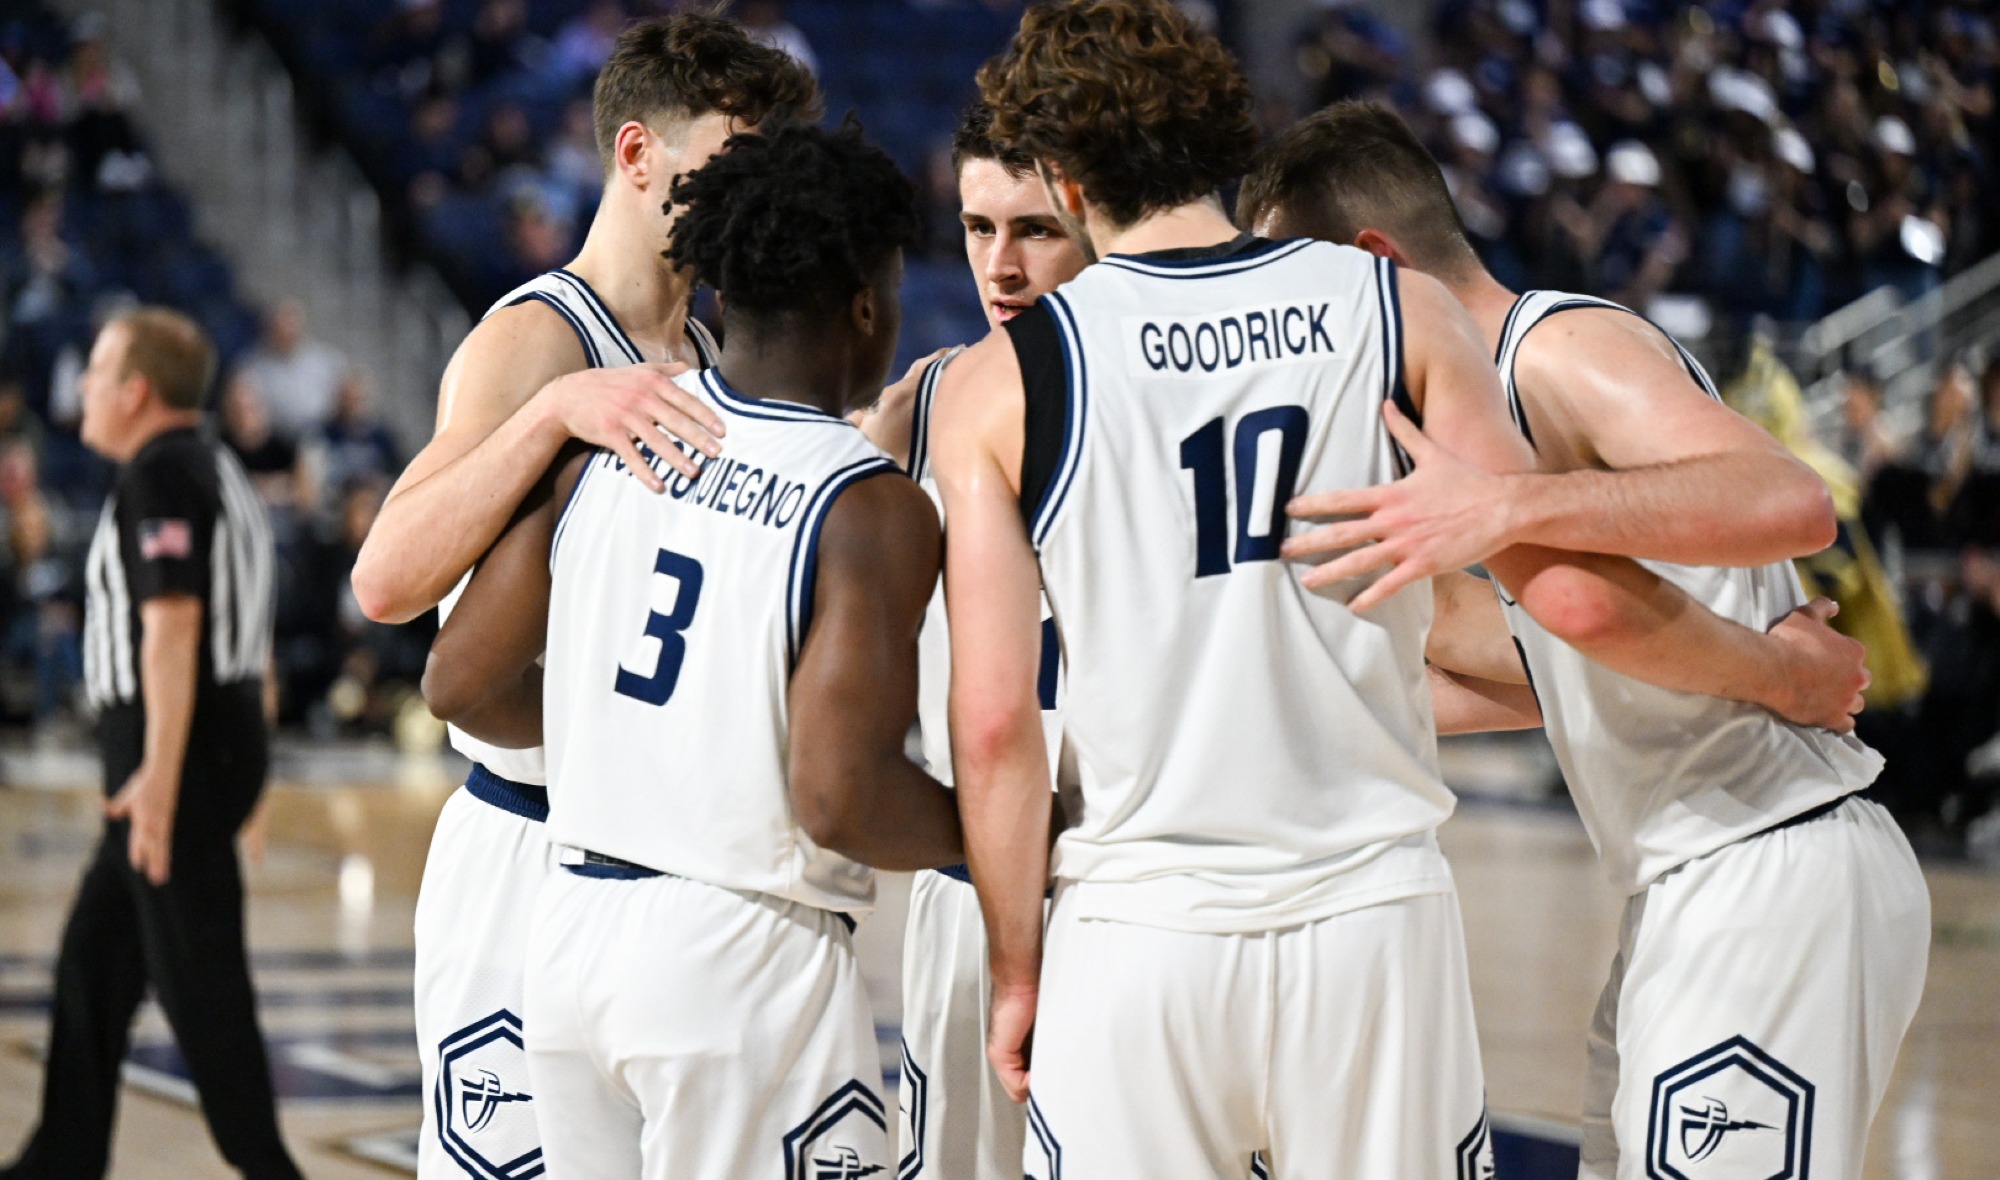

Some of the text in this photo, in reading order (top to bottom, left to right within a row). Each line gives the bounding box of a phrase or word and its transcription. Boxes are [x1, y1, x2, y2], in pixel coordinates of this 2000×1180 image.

[1140, 303, 1335, 372] GOODRICK
[1180, 405, 1310, 579] 10
[614, 548, 704, 706] 3
